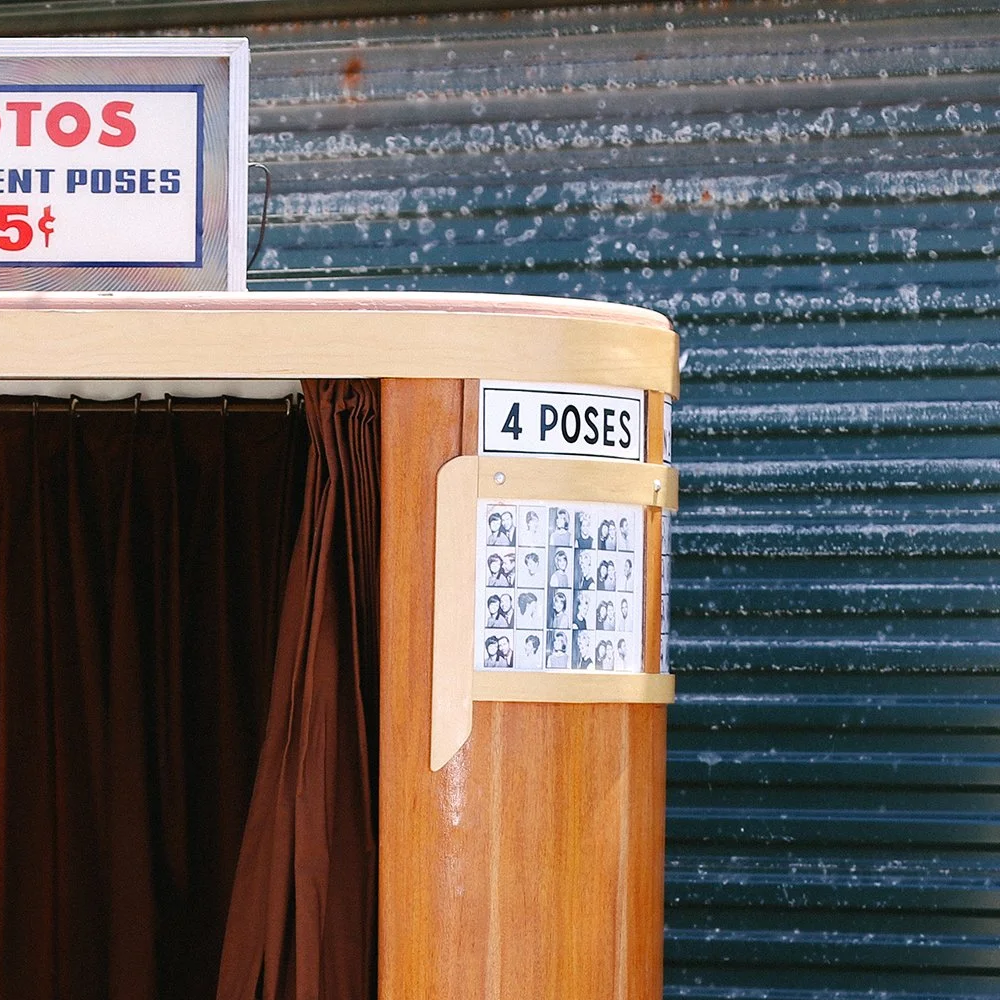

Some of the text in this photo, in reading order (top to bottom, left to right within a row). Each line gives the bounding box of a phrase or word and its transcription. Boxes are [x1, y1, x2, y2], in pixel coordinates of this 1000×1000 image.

[66, 168, 181, 194] POSES
[500, 402, 523, 441] 4
[540, 403, 631, 449] POSES
